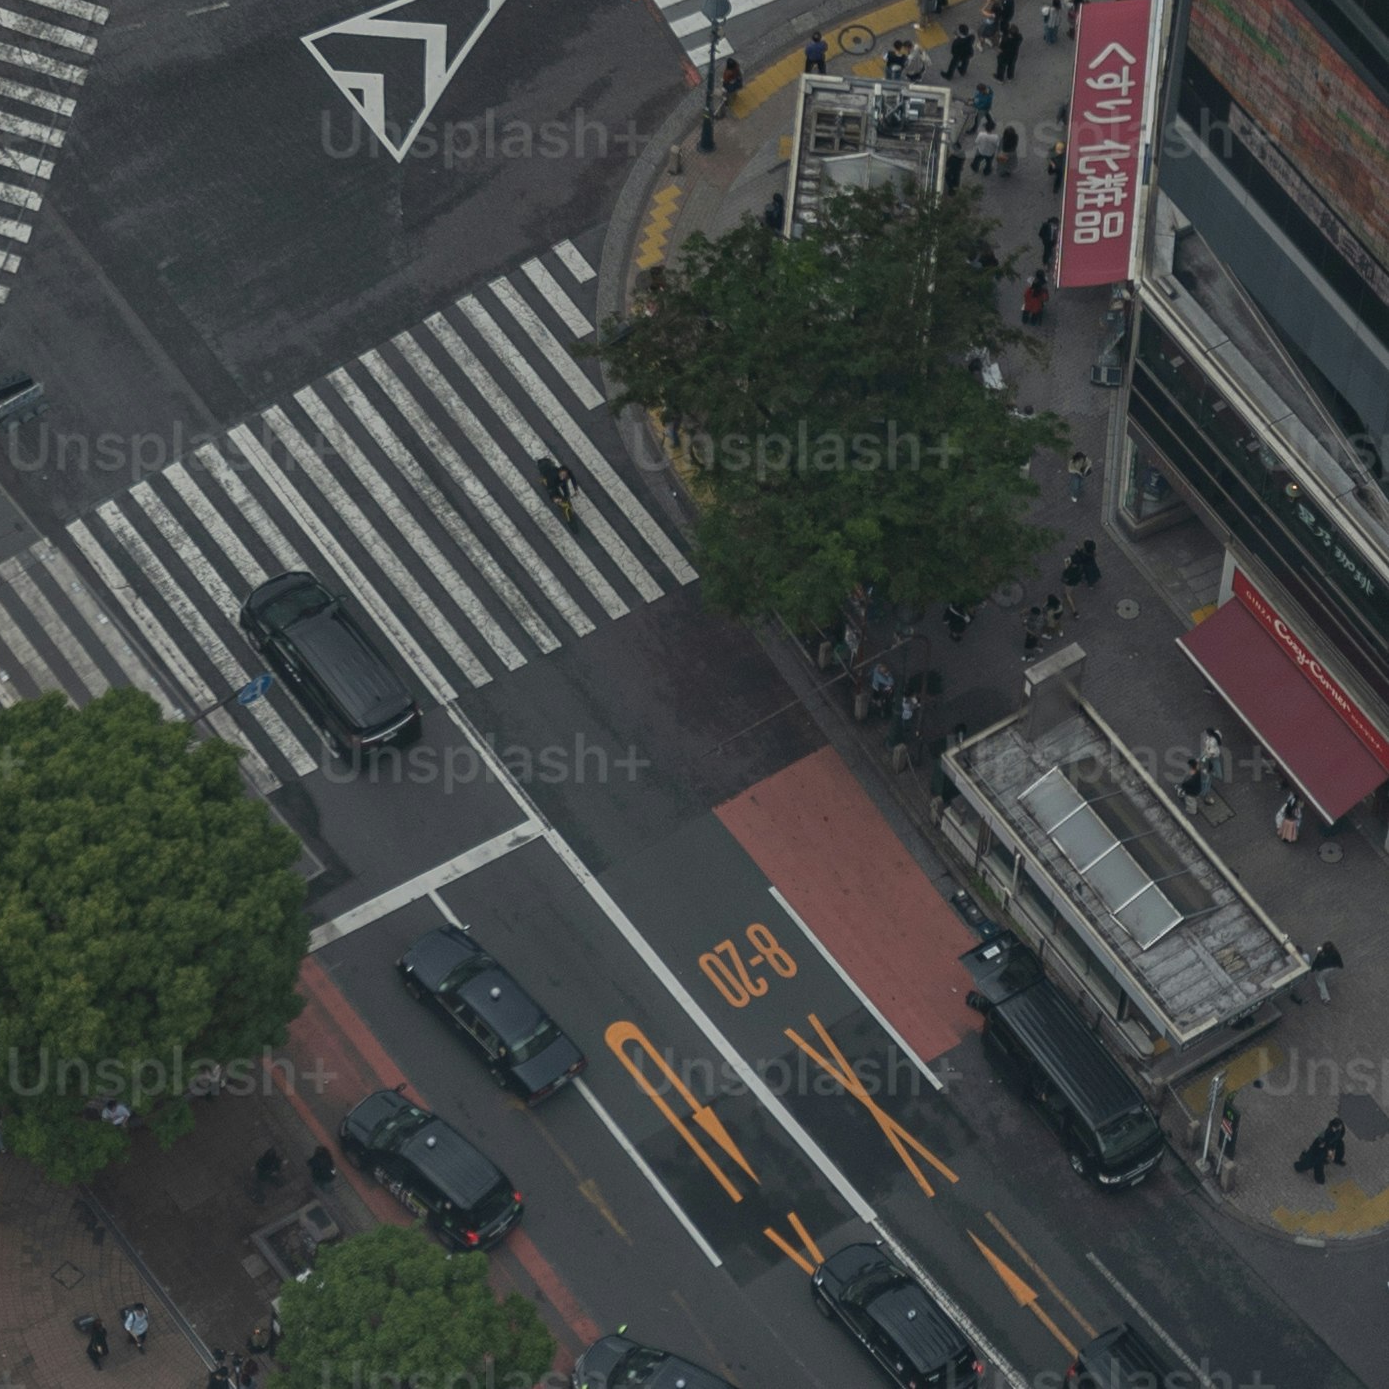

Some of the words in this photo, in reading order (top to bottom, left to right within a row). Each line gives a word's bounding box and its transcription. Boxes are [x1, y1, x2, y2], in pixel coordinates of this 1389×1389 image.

[1085, 41, 1137, 126] くすり
[1073, 141, 1134, 246] 化粧品
[1273, 618, 1309, 668] Cozy
[1308, 660, 1351, 713] Corner
[699, 923, 798, 1009] 8-20
